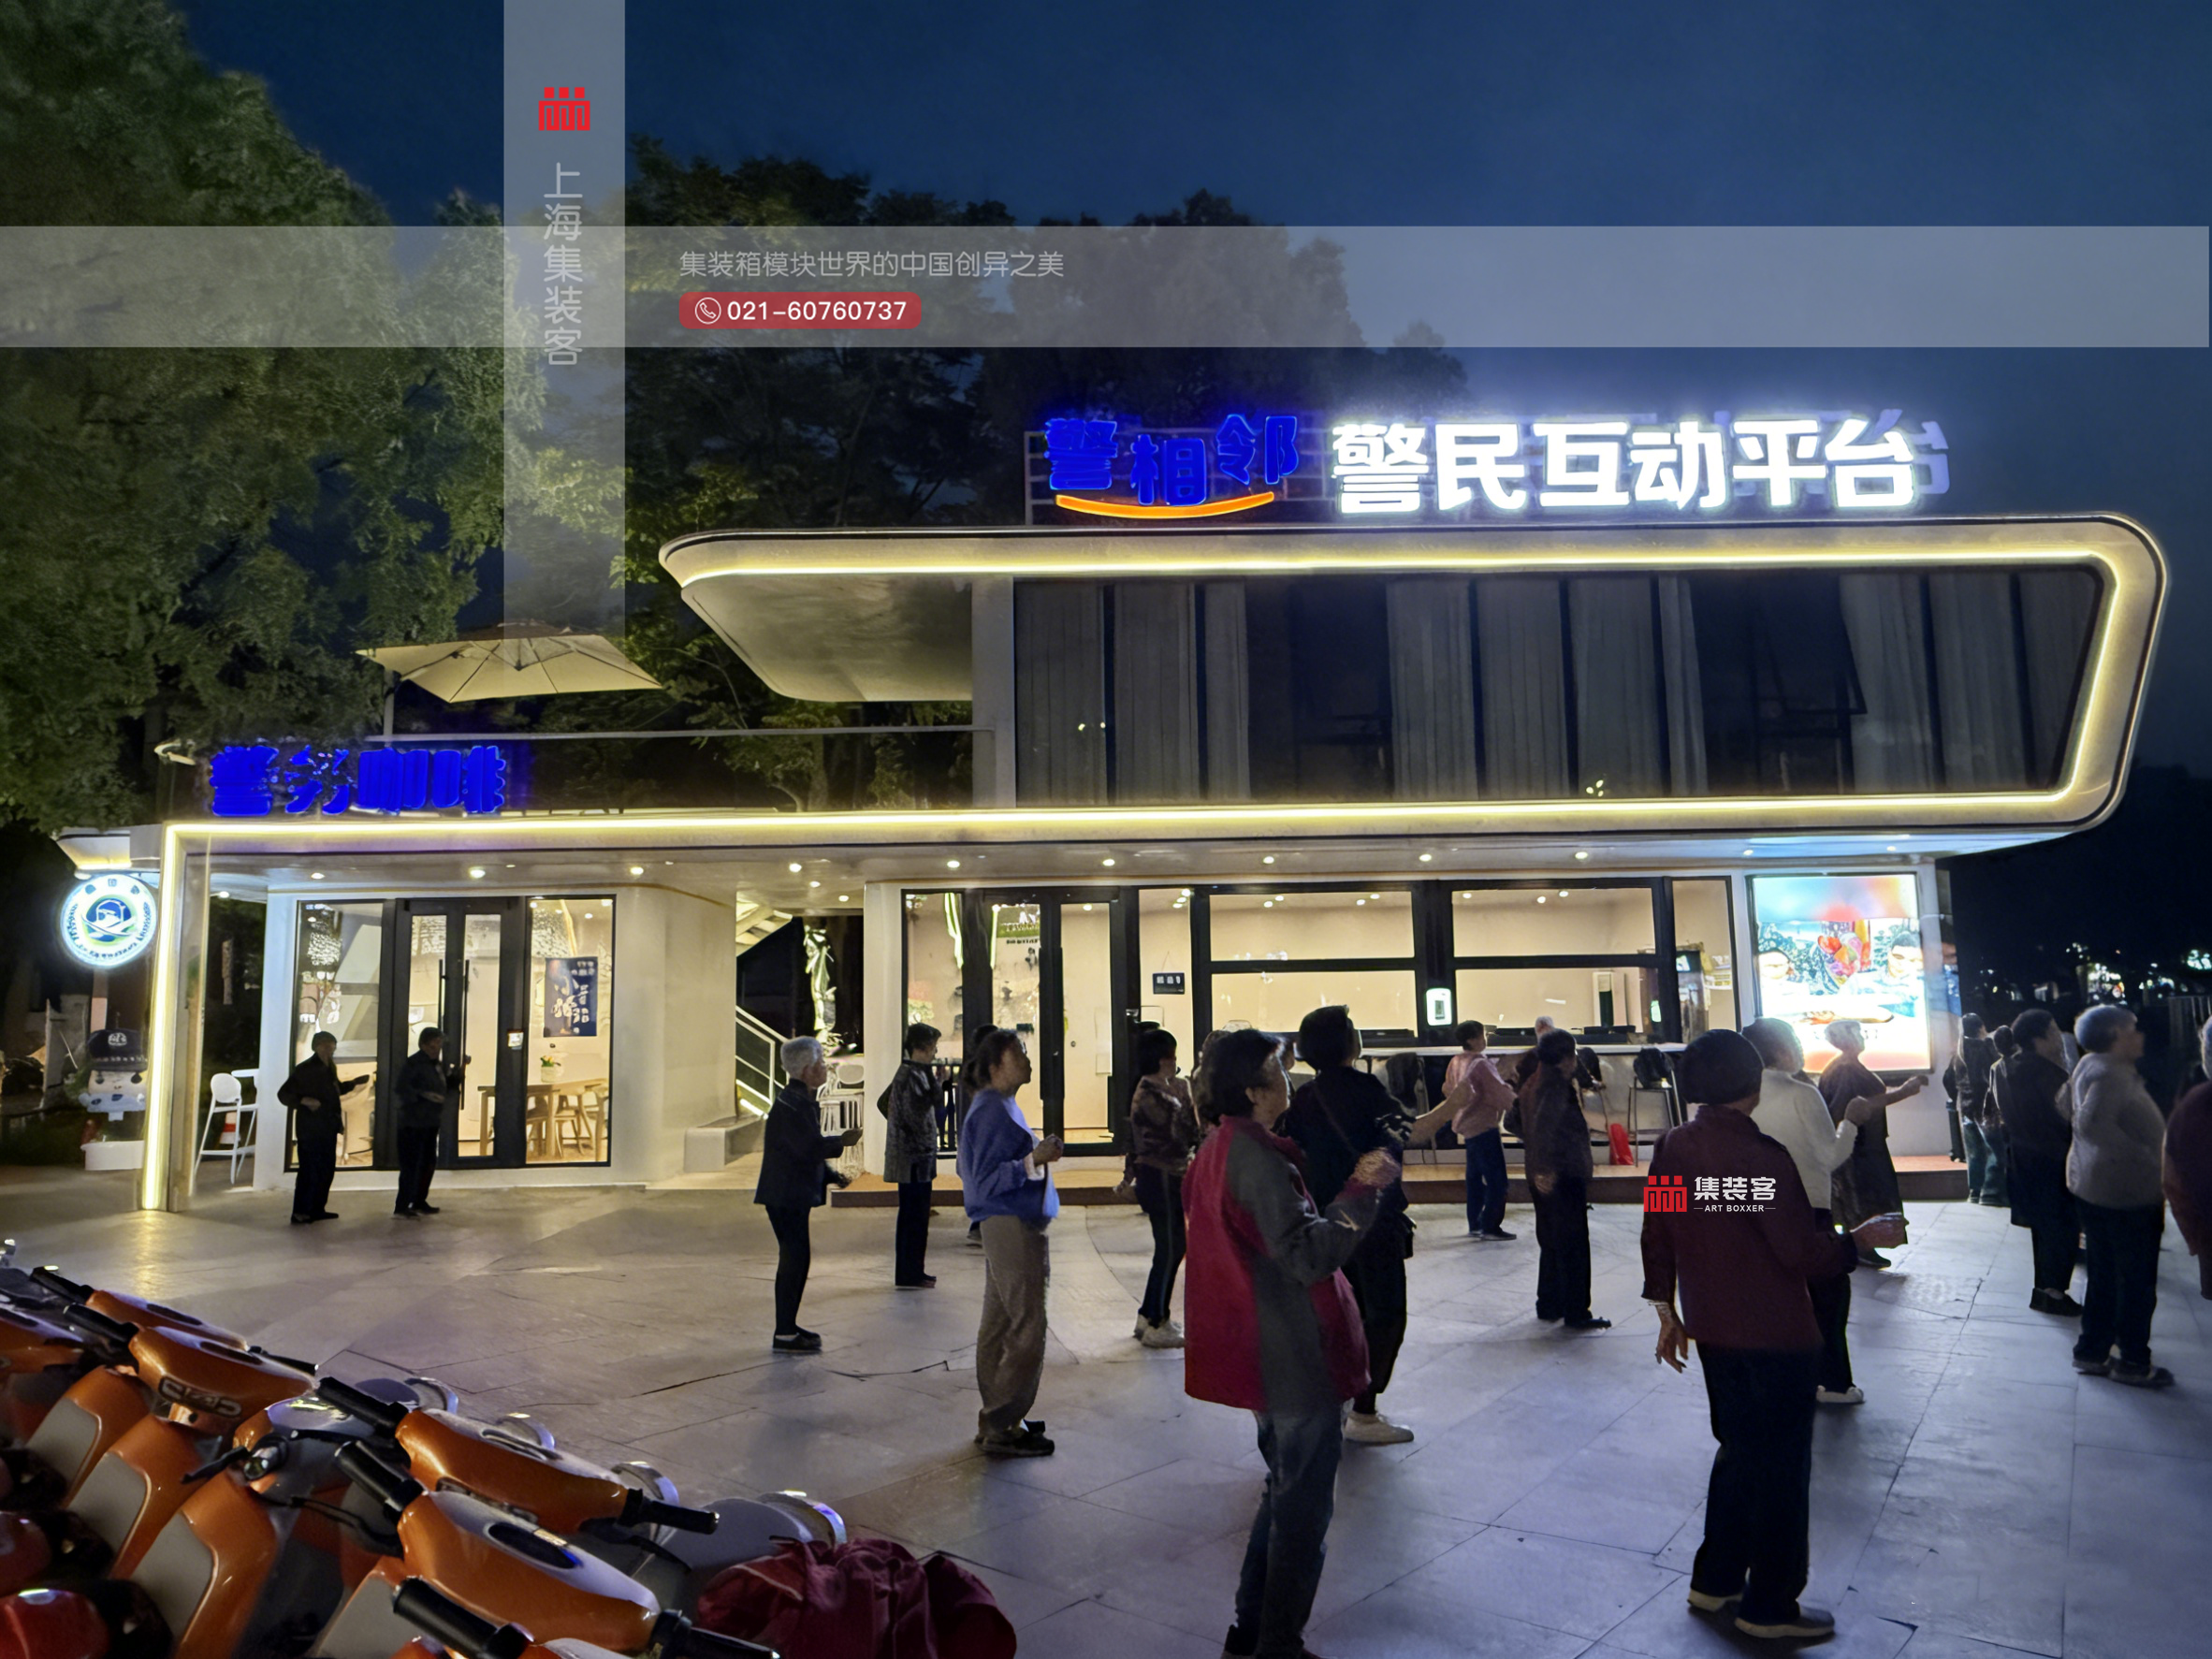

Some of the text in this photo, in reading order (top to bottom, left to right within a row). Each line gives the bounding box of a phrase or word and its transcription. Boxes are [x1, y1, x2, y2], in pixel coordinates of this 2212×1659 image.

[1332, 419, 1914, 514] 警民互动平台
